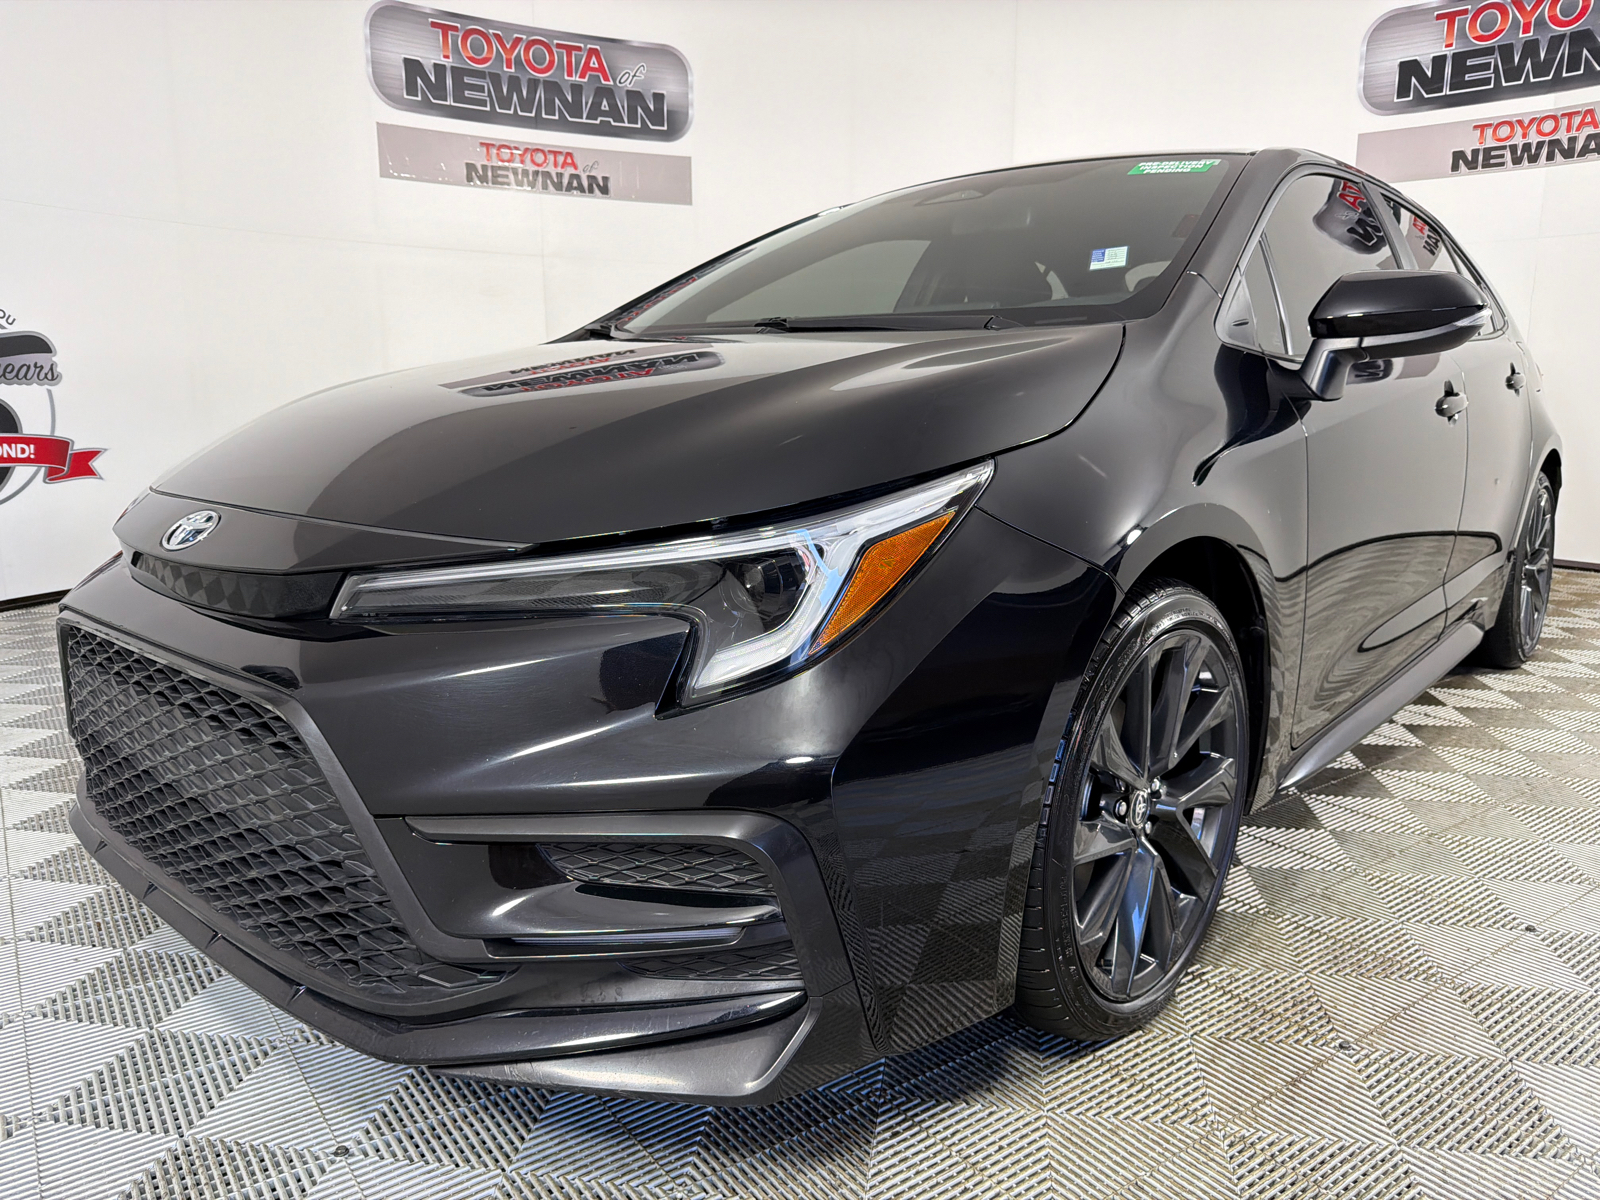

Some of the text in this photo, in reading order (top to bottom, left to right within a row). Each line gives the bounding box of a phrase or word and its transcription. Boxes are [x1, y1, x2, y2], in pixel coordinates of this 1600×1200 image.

[1434, 0, 1594, 50] TOYO
[429, 19, 646, 86] TOYOTA of
[403, 57, 667, 130] NEWNAN
[1472, 107, 1600, 145] TOYOTA
[480, 142, 599, 173] TOYOTA of
[1450, 133, 1600, 173] NEWNA
[465, 162, 609, 195] NEWNAN
[0, 361, 59, 382] ears
